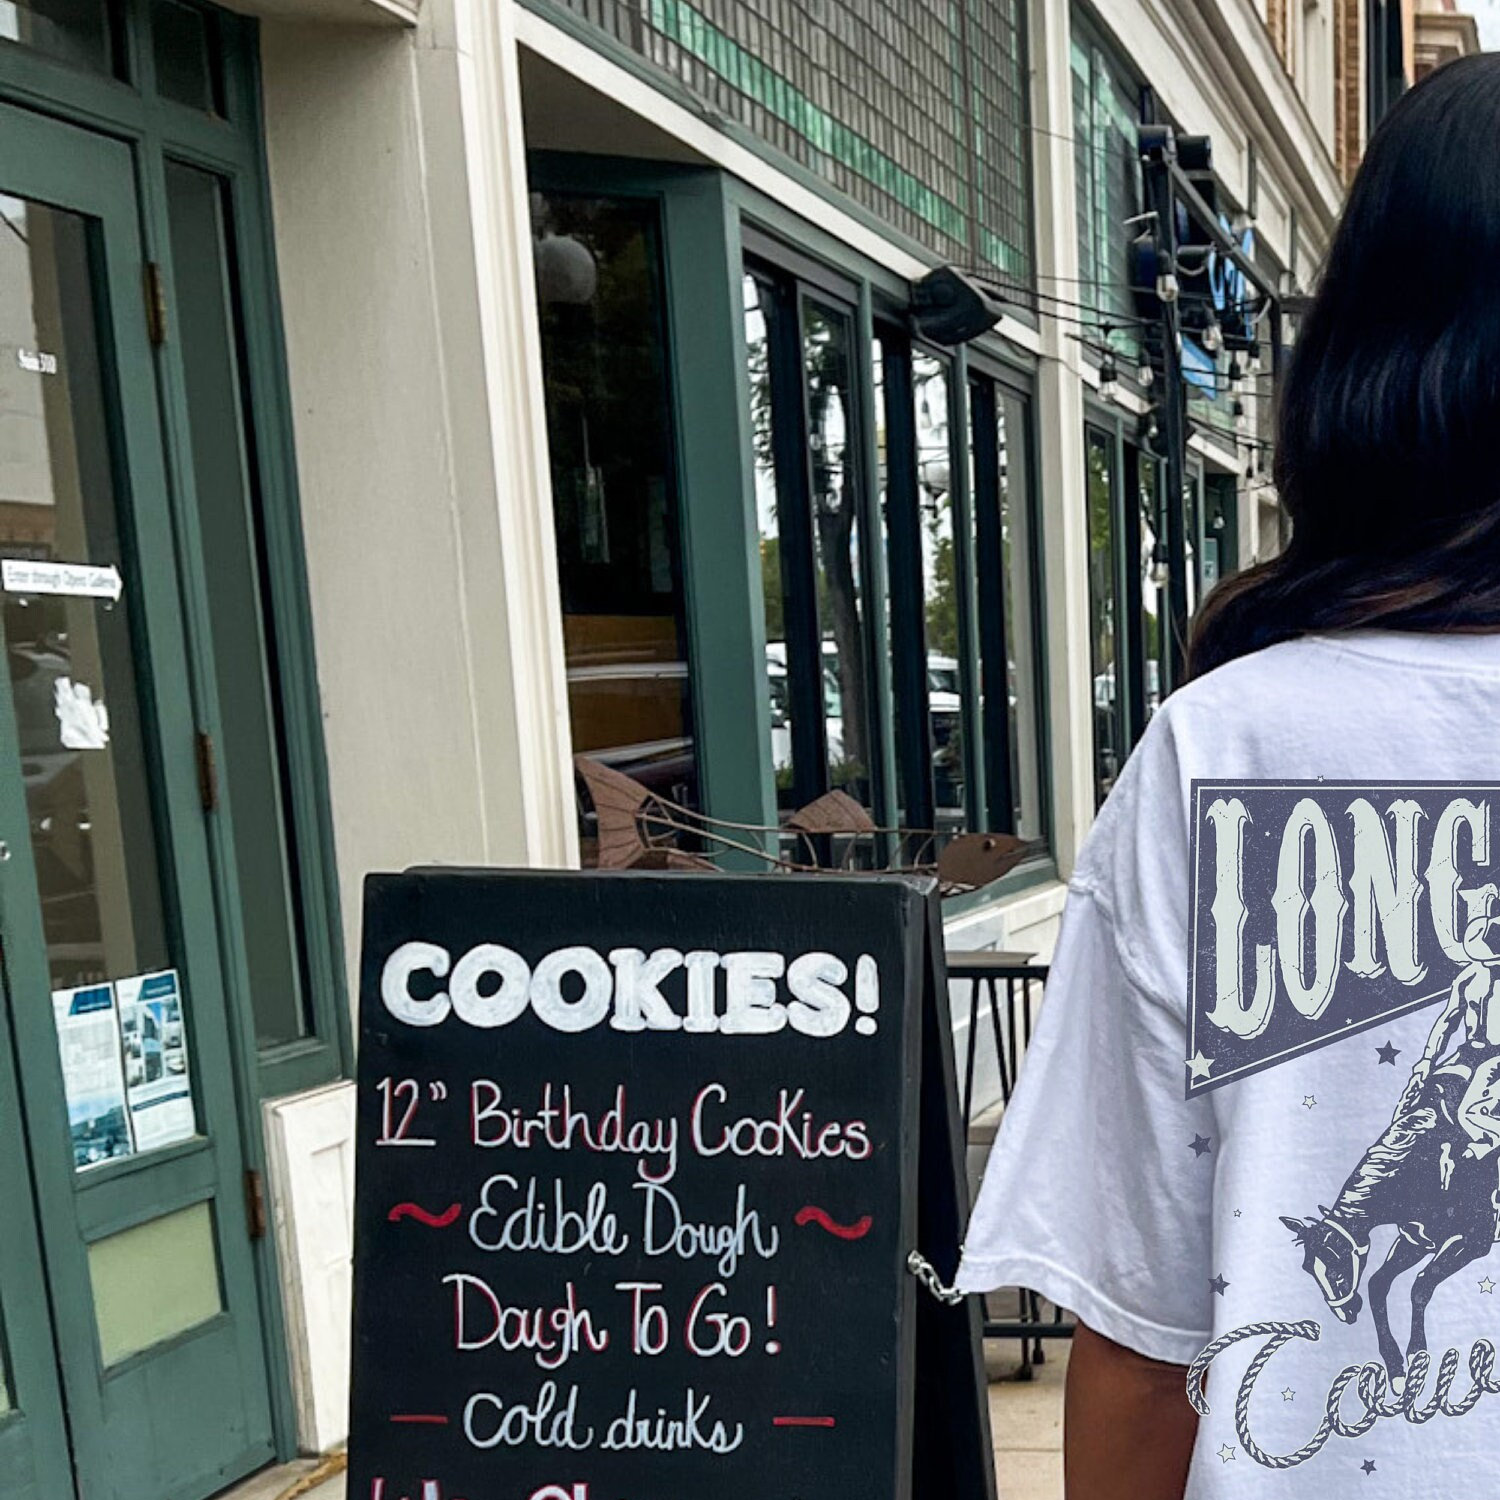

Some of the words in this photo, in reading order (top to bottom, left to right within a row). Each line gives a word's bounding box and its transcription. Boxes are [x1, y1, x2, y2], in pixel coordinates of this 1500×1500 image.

[380, 941, 880, 1037] COOKIES!
[471, 1079, 678, 1184] Birthday
[468, 1174, 629, 1255] Edible
[632, 1180, 779, 1277] Dough
[614, 1282, 669, 1356] To
[463, 1380, 594, 1450] Cold
